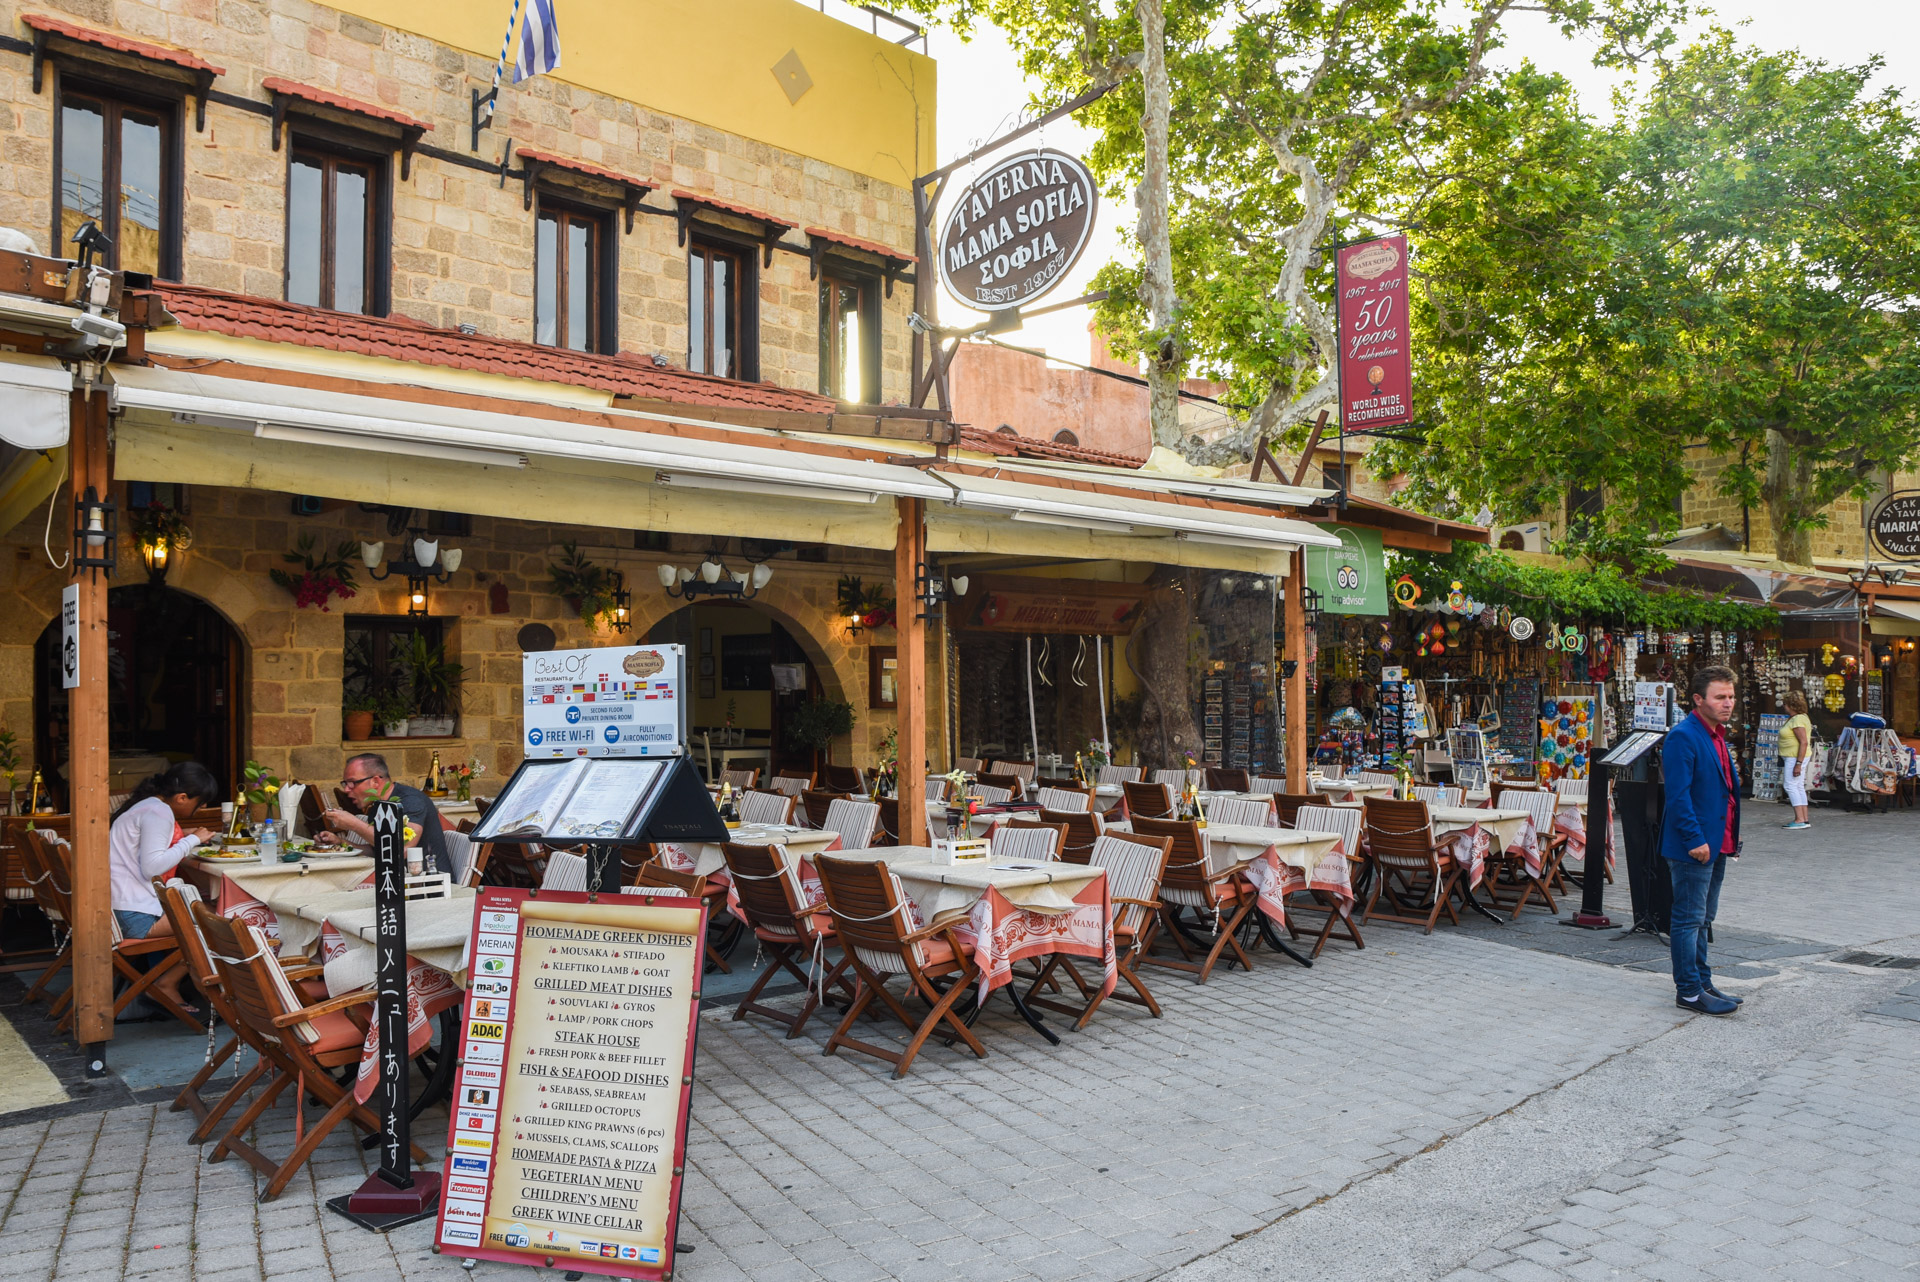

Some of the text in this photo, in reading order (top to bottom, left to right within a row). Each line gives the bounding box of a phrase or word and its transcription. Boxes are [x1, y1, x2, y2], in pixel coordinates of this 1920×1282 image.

[954, 160, 1068, 237] TAVERNA
[949, 182, 1084, 272] MAMA SOFIA
[980, 231, 1058, 285] ΣΟΦΙΑ
[976, 247, 1065, 302] EST 1967
[1346, 286, 1367, 298] 1967
[1378, 278, 1401, 291] 2017
[1355, 296, 1392, 331] 50
[1349, 328, 1397, 359] years
[1358, 347, 1399, 361] celebration
[1352, 394, 1400, 410] WORLD WIDE
[1348, 405, 1405, 422] RECOMMENDED
[1882, 500, 1916, 518] STEAK
[1885, 539, 1916, 553] SNACK
[1332, 594, 1366, 606] tripadvisor
[535, 653, 592, 680] Best Of
[546, 730, 594, 742] FREE WI-FI
[623, 734, 672, 742] AIRCONDITIONED
[1073, 919, 1100, 929] MAMA
[526, 926, 692, 946] HOMEMADE GREEK DISHES
[479, 939, 514, 950] MERIAN
[561, 947, 665, 960] MOUSAKA STIFADO
[552, 962, 670, 977] KLEFTIKO LAMB GOAT
[477, 982, 508, 994] mako
[534, 977, 673, 997] GRILLED MEAT DISHES
[559, 997, 656, 1012] SOUVLAKI GYROS
[558, 1014, 653, 1028] LAMP / PORK CHOPS
[472, 1024, 502, 1037] ADAC
[555, 1031, 640, 1047] STEAK HOUSE
[539, 1048, 666, 1066] FRESH PORK & BEEF FILLET
[520, 1063, 669, 1086] FISH & SEAFOOD DISHES
[550, 1085, 646, 1101] SEABASS, SEABREAM
[551, 1101, 641, 1117] GRILLED OCTOPUS
[524, 1116, 665, 1138] GRILLED KING PRAWNS (6 pcs)
[526, 1133, 659, 1153] MUSSELS, CLAMS, SCALLOPS
[512, 1148, 656, 1173] HOMEMADE PASTA & PIZZA
[522, 1168, 643, 1190] VEGETERIAN MENU
[450, 1182, 483, 1193] Frommer's
[521, 1187, 638, 1210] CHILDREN’S MENU
[512, 1205, 643, 1230] GREEK WINE CELLAR
[489, 1233, 503, 1242] FREE
[543, 1244, 570, 1252] AIRCONDITION
